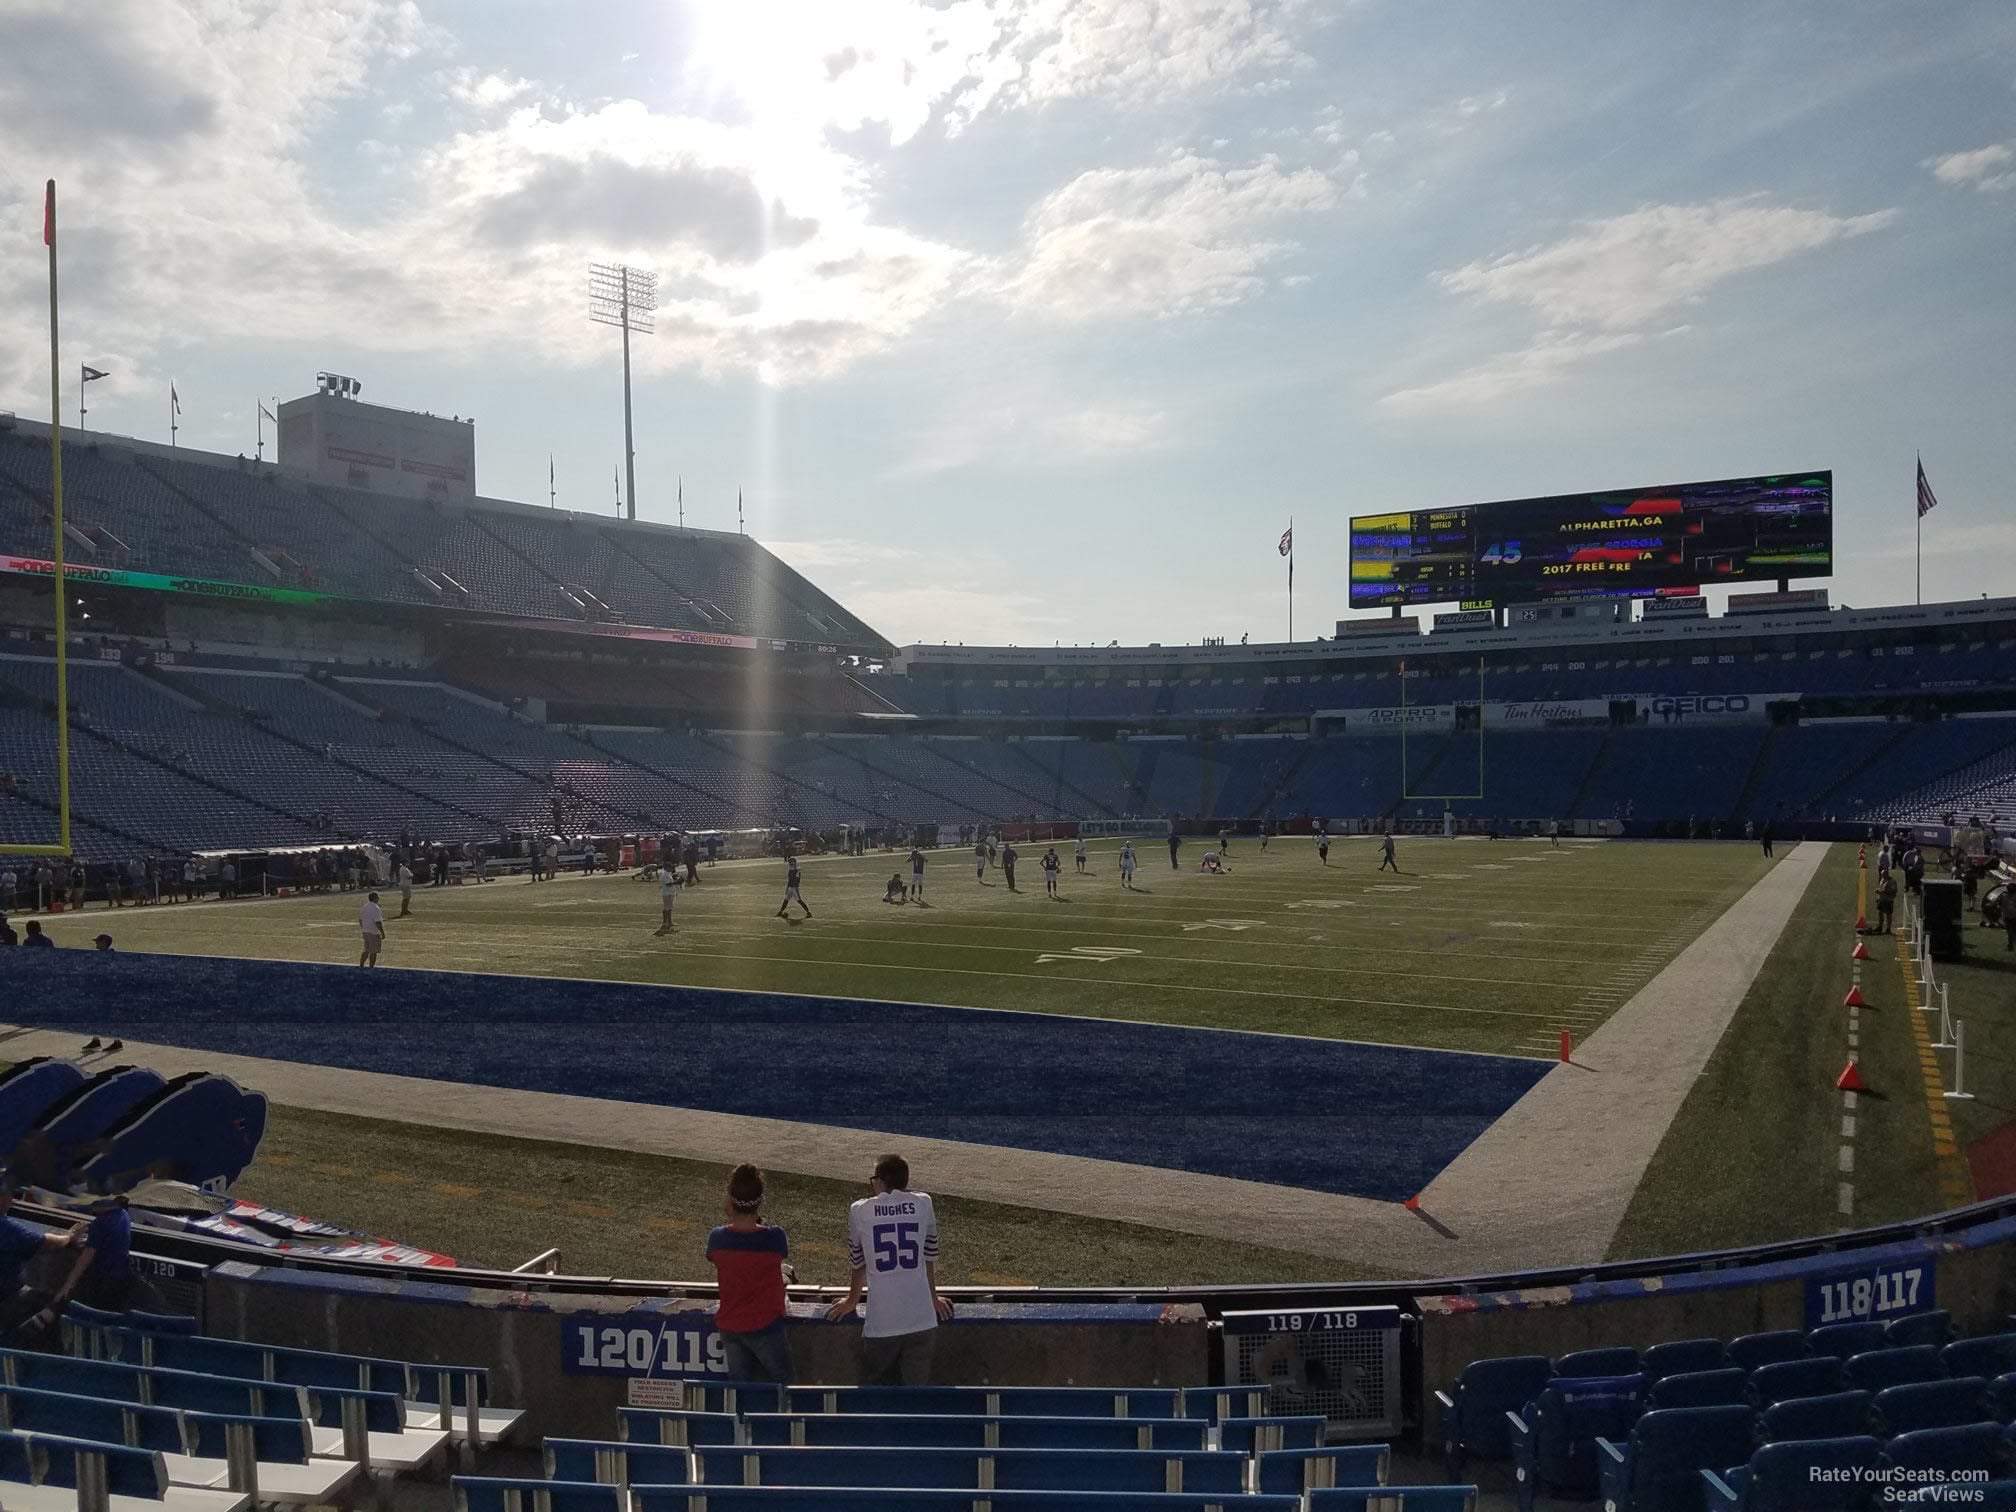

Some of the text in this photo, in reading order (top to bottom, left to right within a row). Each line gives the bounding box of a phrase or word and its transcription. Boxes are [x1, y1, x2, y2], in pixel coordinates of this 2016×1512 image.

[1480, 540, 1522, 565] 45
[1542, 564, 1572, 575] 2017
[1576, 562, 1605, 573] FREE
[1461, 600, 1493, 610] BILLS
[1503, 702, 1583, 719] Tim Hortons
[1651, 696, 1750, 714] GEICO
[874, 1202, 916, 1217] HUGHES
[872, 1222, 920, 1272] 55
